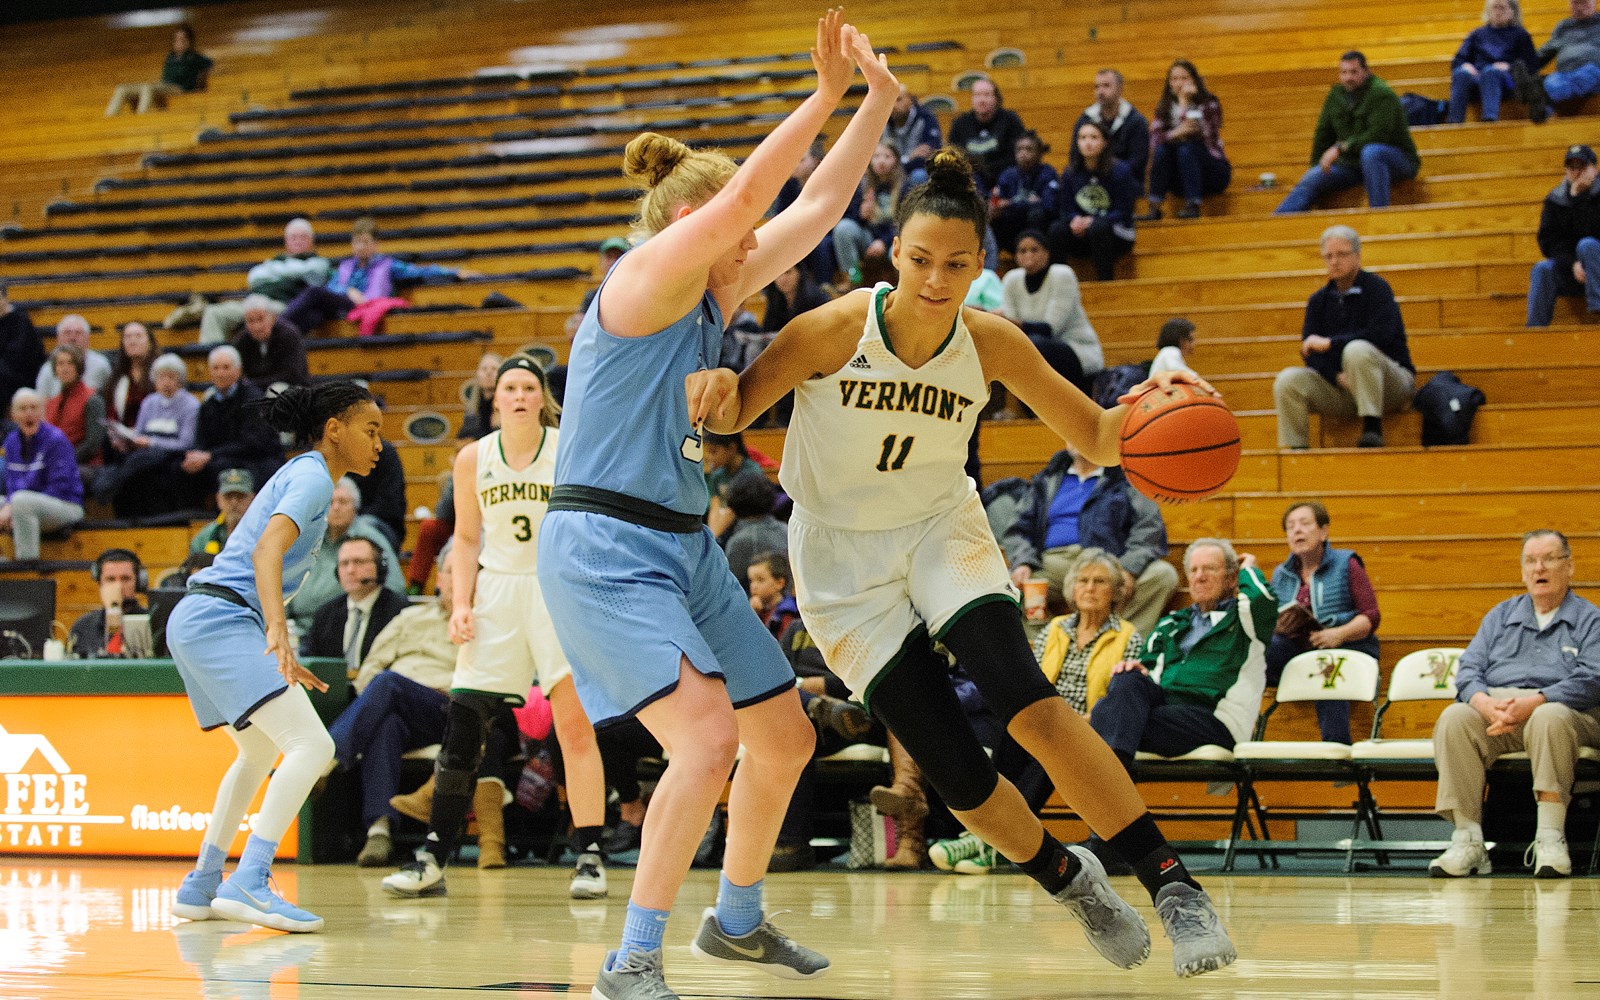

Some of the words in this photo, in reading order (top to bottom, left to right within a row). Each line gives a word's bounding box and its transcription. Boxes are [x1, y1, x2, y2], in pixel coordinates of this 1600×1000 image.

[839, 379, 975, 423] VERMONT
[875, 433, 916, 472] 11
[481, 482, 553, 508] VERMON
[511, 514, 532, 543] 3
[4, 773, 90, 815] FEE
[0, 824, 83, 846] TATE
